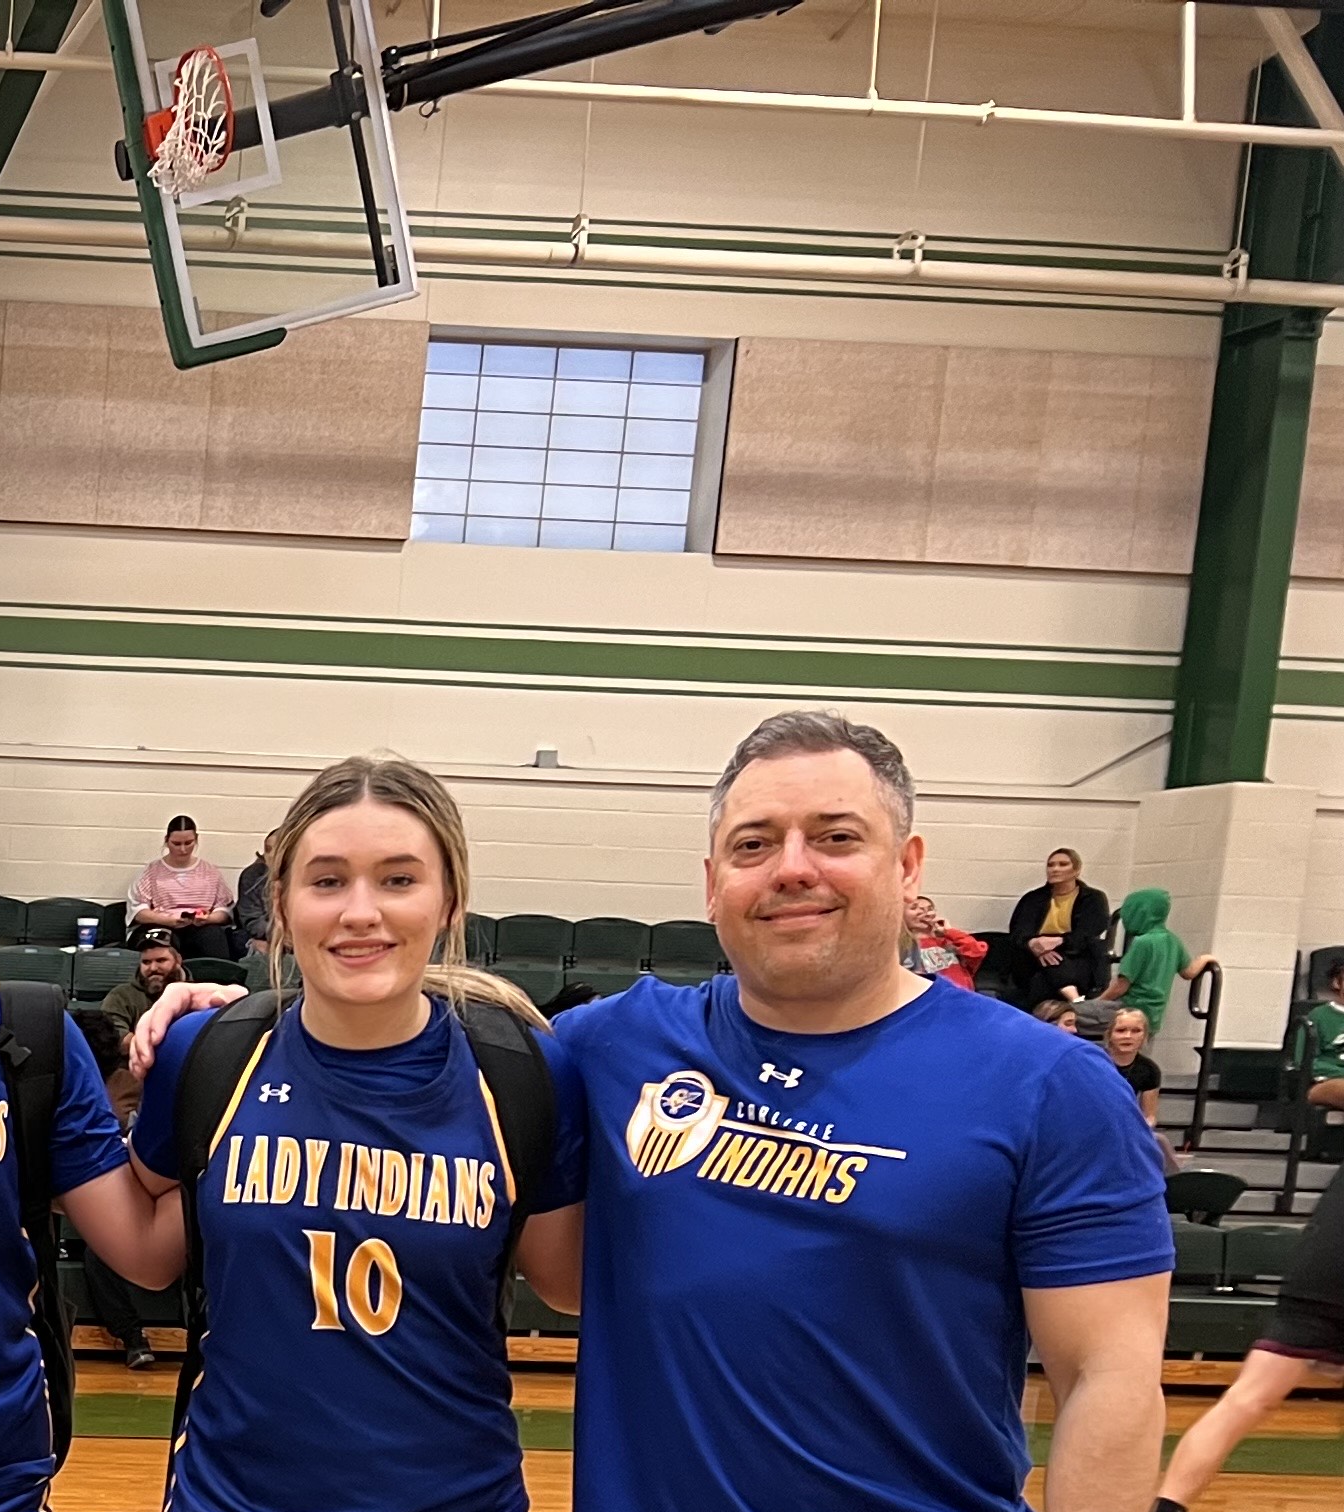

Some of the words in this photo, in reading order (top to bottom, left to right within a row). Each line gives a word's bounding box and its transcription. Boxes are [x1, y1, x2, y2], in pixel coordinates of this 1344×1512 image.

[222, 1135, 330, 1207] LADY
[334, 1142, 496, 1229] INDIANS
[696, 1131, 869, 1204] INDIANS
[302, 1229, 403, 1336] 10
